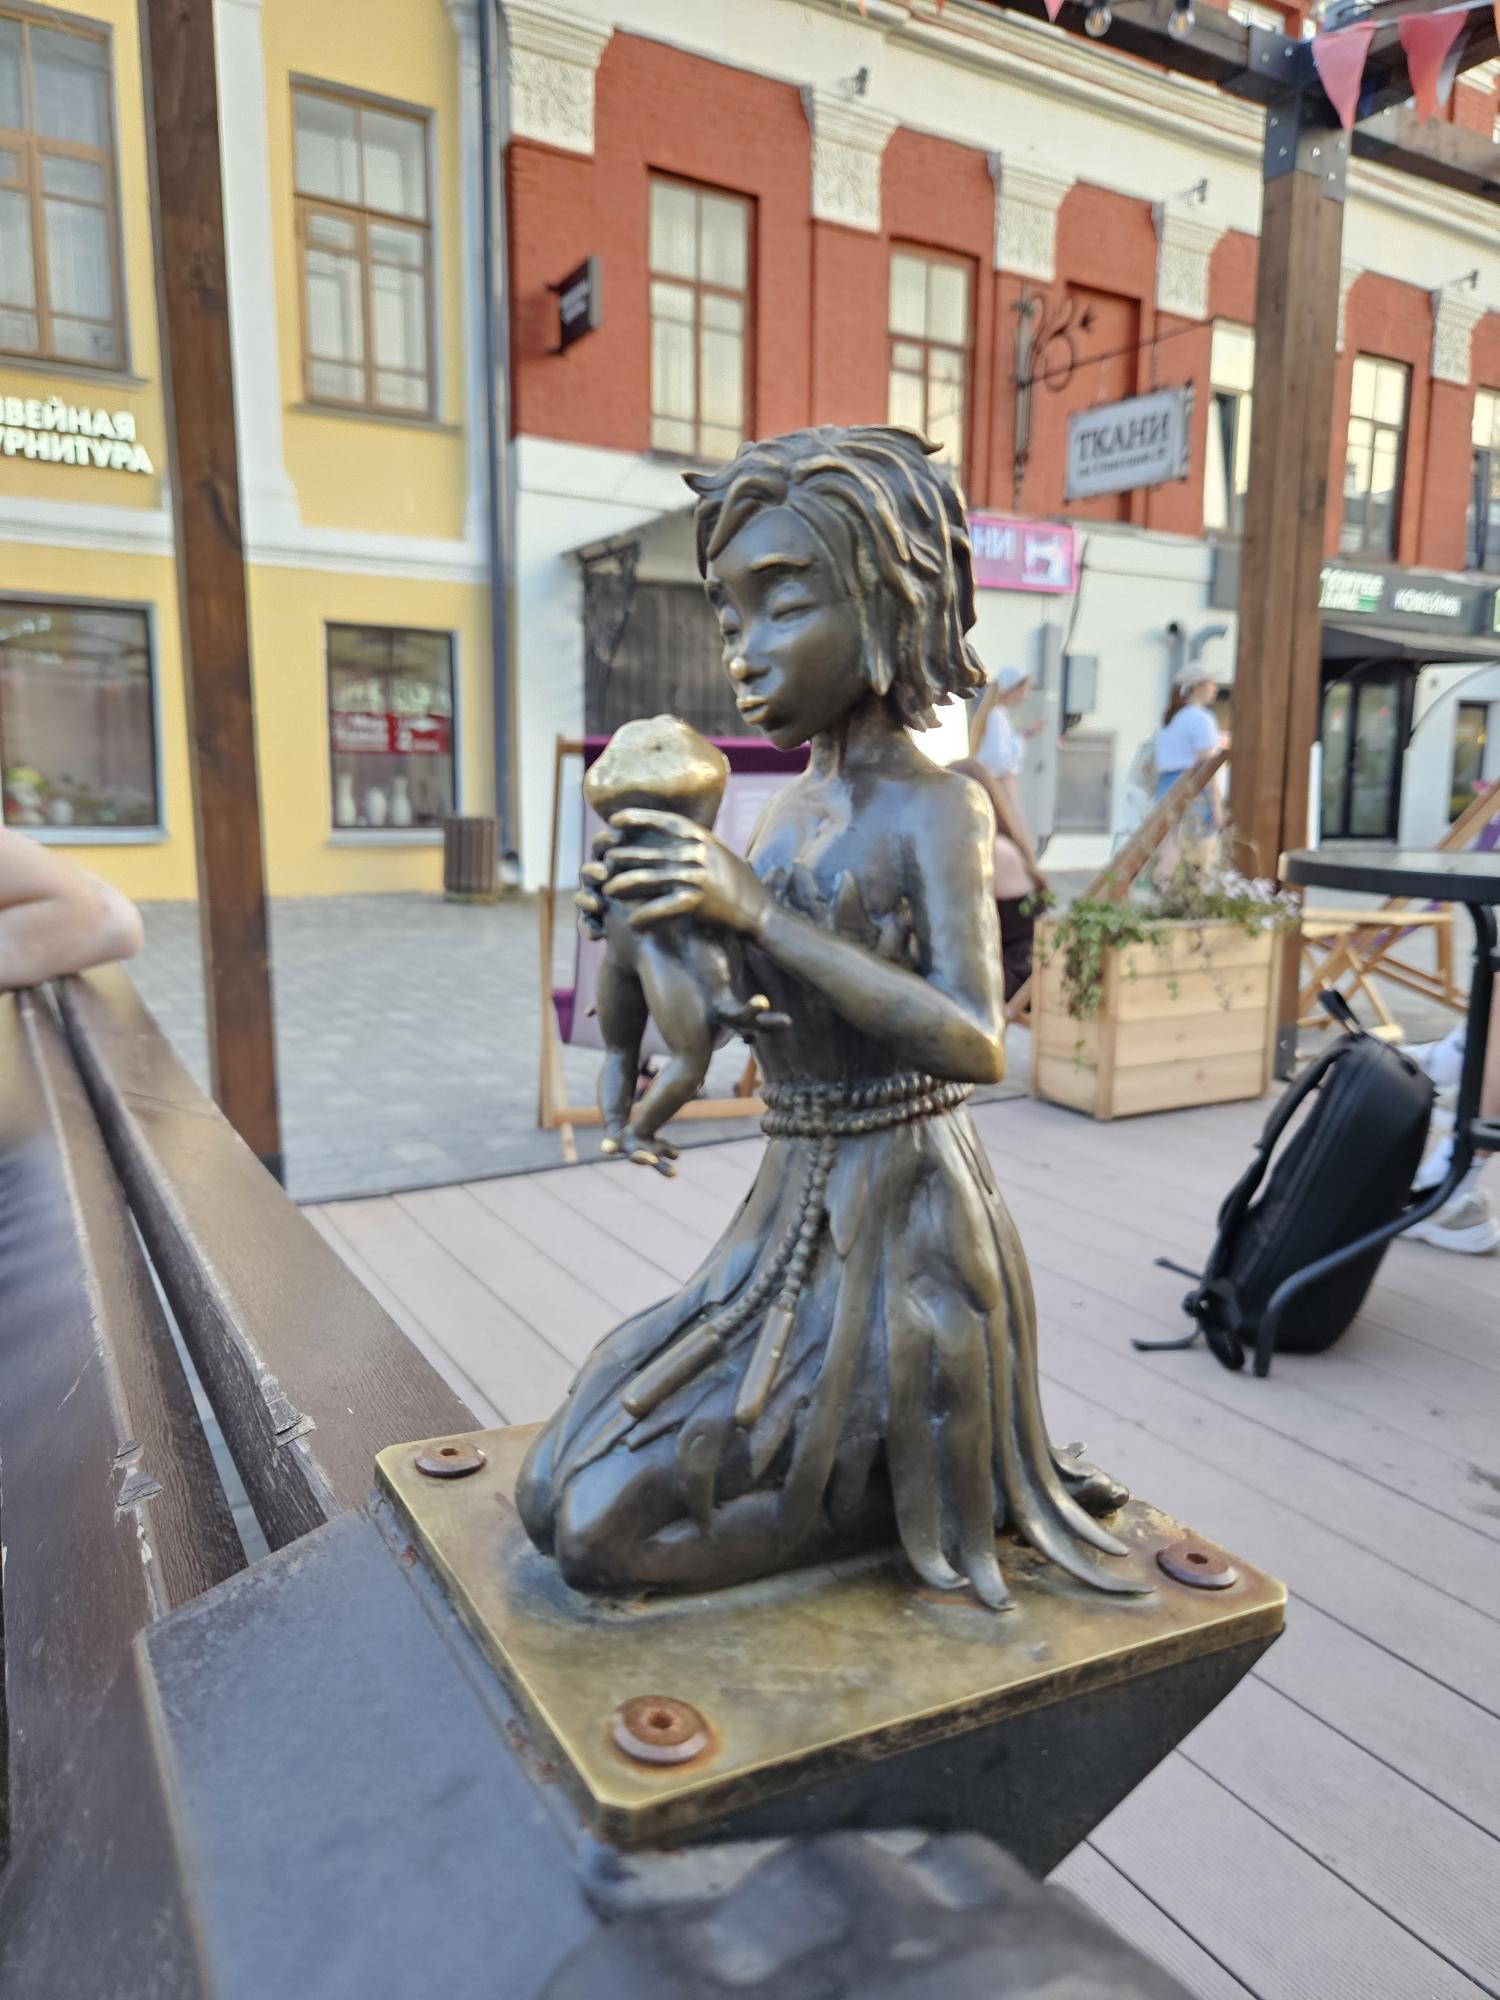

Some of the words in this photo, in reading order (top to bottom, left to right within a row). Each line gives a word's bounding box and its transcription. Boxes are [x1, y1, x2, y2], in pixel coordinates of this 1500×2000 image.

[0, 395, 136, 442] ВЕЙНАЯ
[1076, 411, 1169, 461] ТКАНИ
[0, 426, 154, 474] РНИТУРА
[971, 523, 1016, 561] НИ
